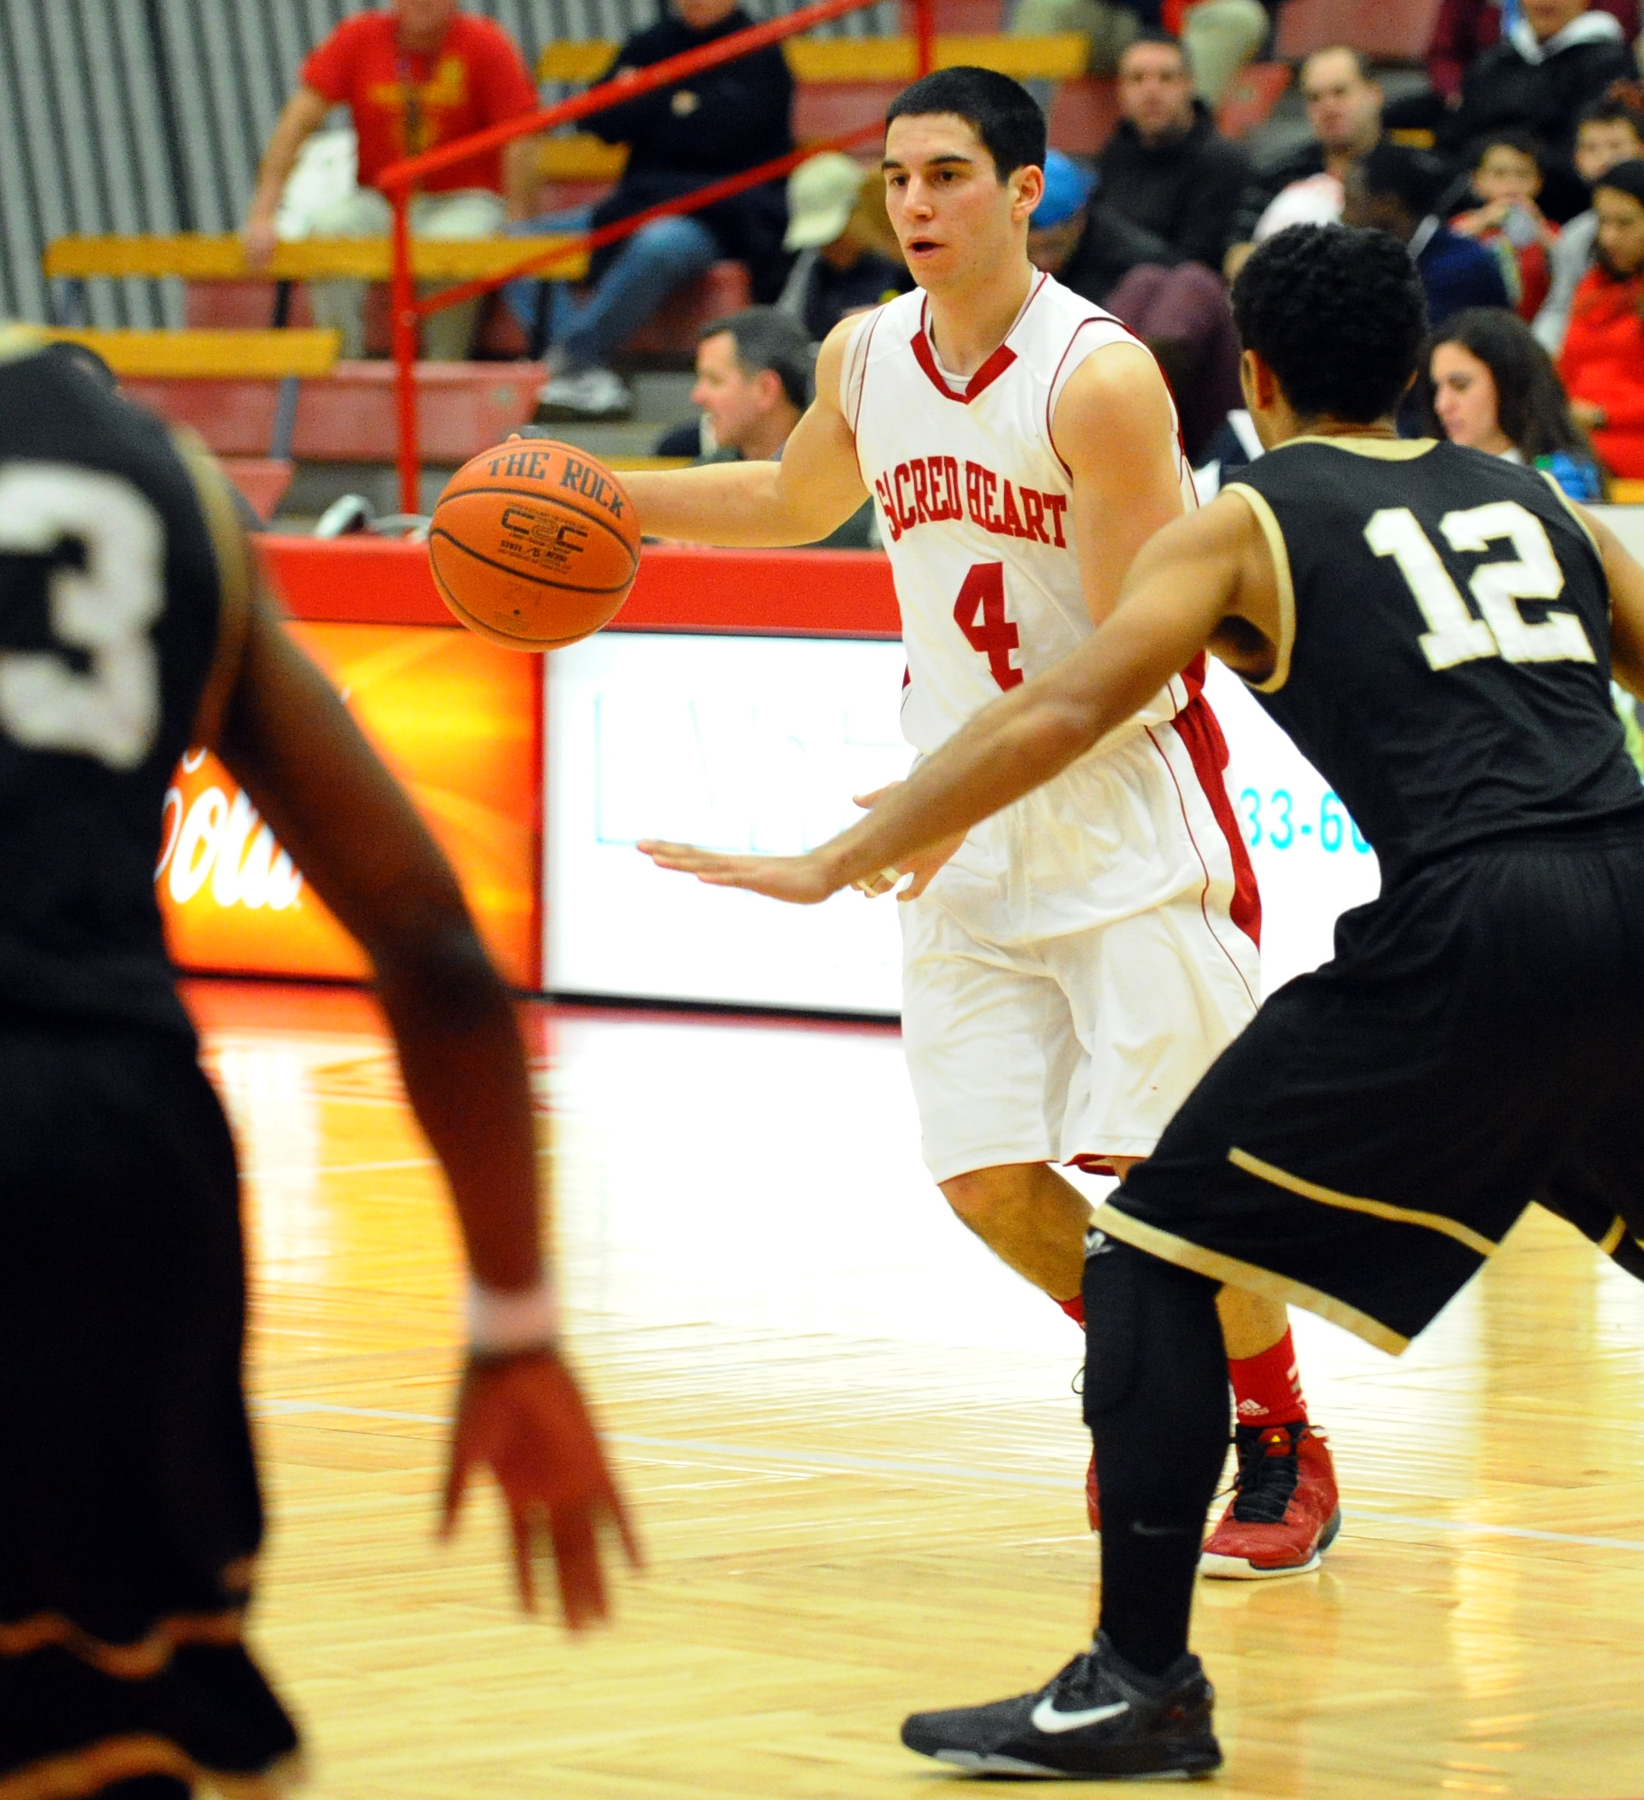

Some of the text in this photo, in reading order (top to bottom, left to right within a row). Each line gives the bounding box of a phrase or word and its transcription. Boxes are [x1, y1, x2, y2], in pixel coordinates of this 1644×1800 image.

[488, 452, 551, 480] THE
[560, 457, 625, 520] ROCK
[875, 455, 1067, 549] SACRED HEART
[953, 561, 1025, 693] 4
[1363, 500, 1597, 672] 12
